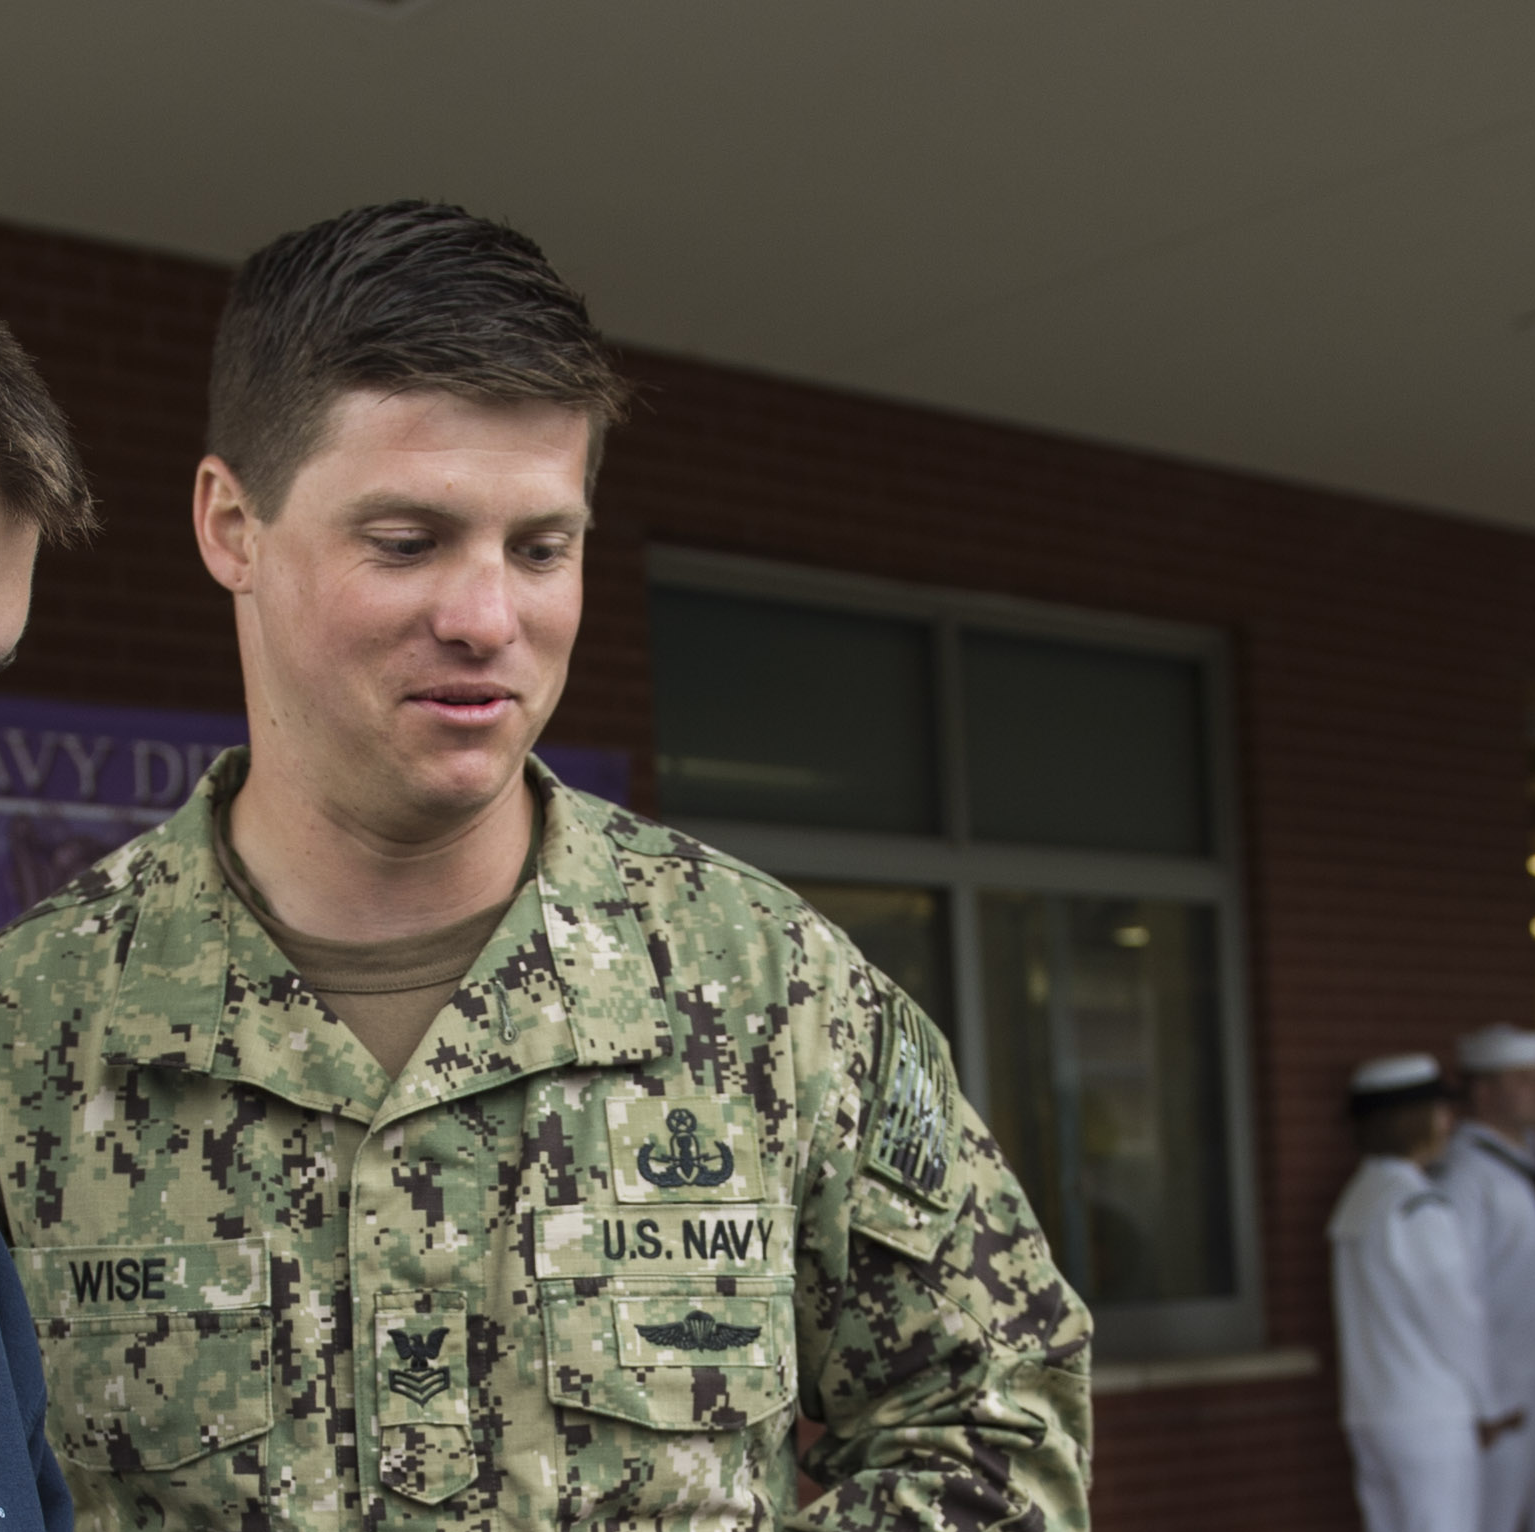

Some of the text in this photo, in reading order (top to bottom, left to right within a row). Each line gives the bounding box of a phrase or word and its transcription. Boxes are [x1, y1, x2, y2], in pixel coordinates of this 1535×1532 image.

[132, 739, 222, 808] DI
[602, 1218, 775, 1262] U.S. NAVY
[70, 1257, 167, 1302] WISE
